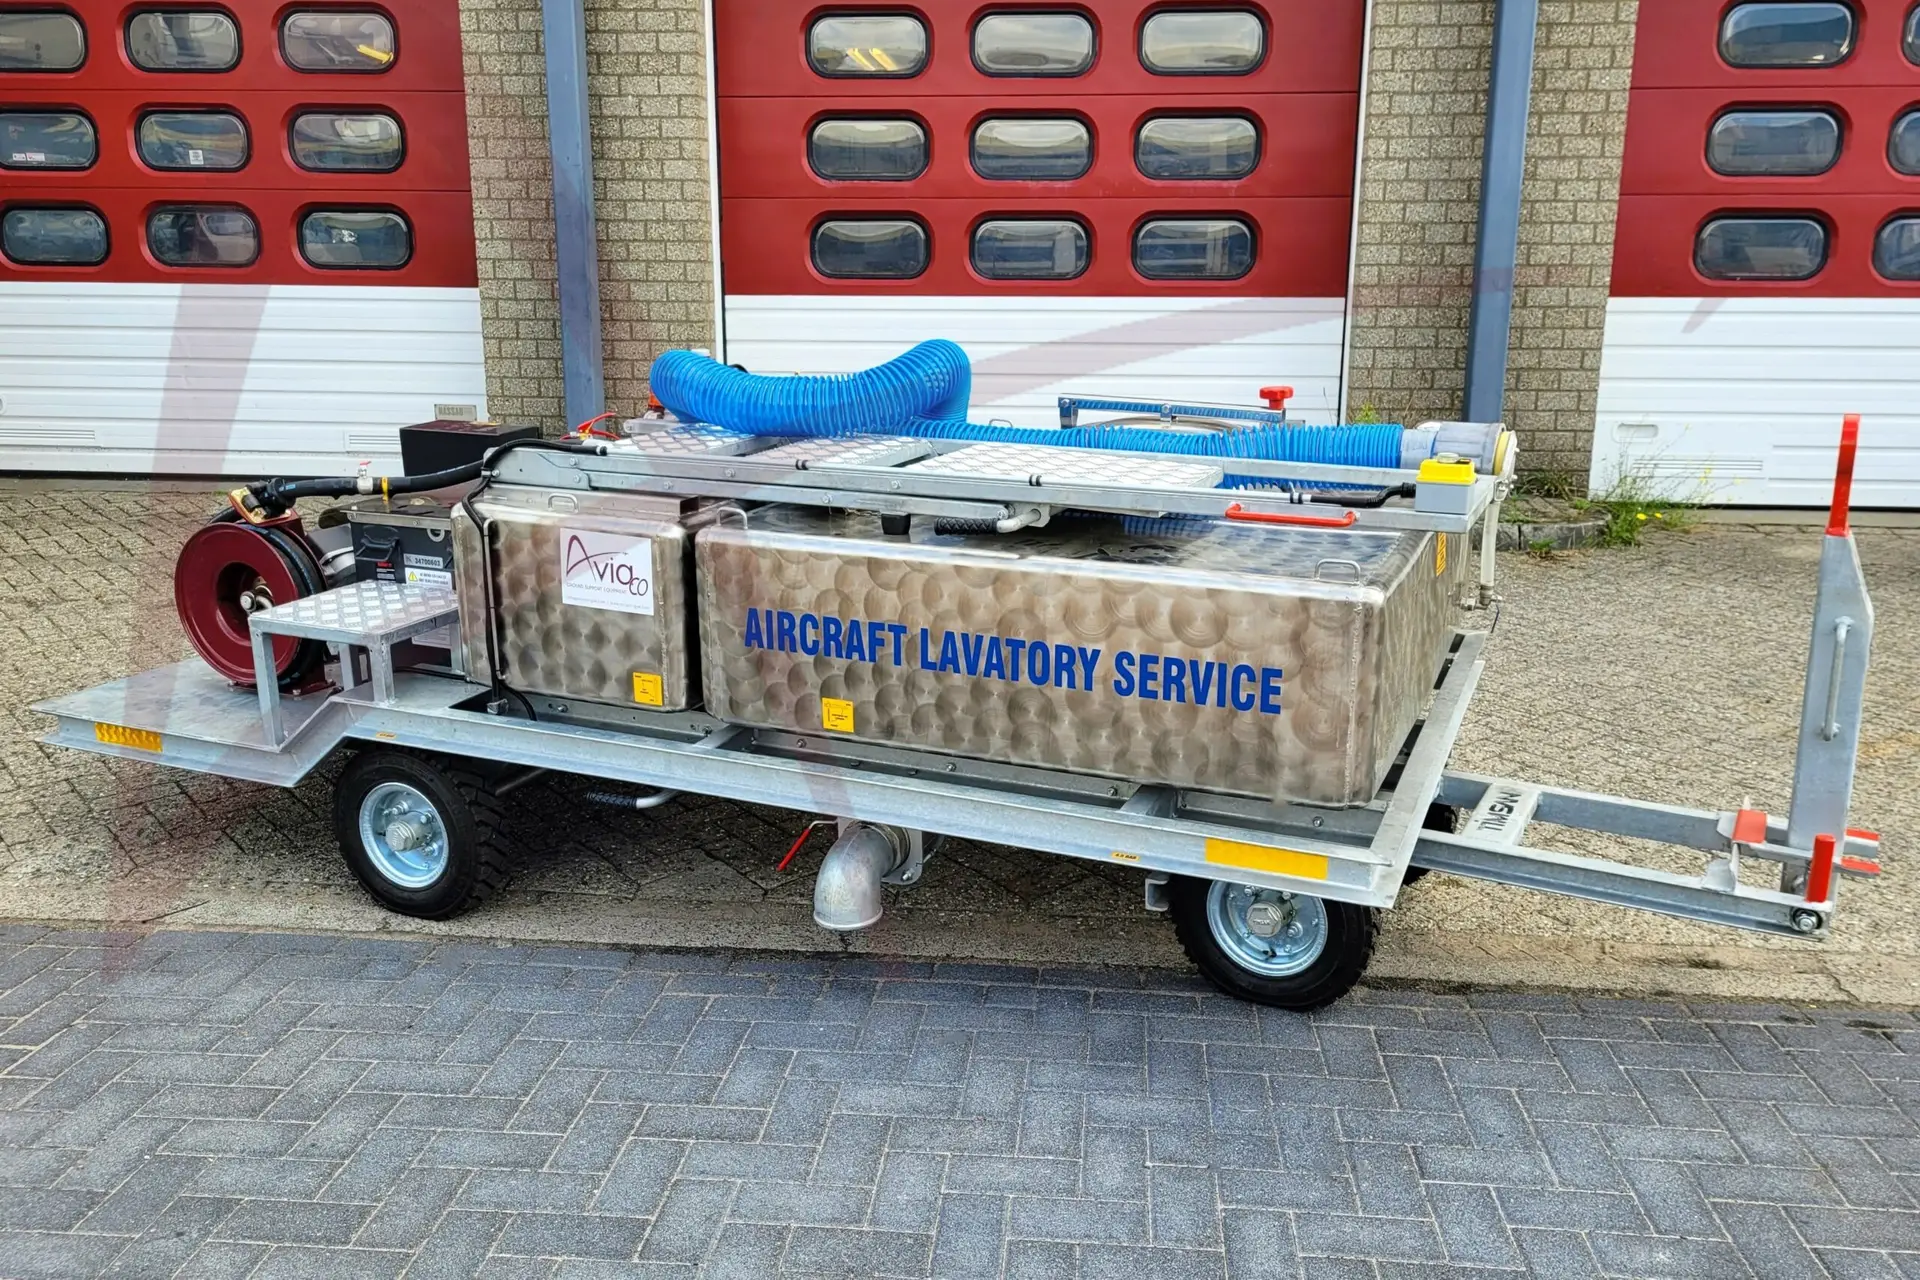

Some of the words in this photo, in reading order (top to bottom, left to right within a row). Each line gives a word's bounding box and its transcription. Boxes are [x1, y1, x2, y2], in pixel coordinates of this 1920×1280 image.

[744, 607, 908, 667] AIRCRAFT
[920, 627, 1102, 692] LAVATORY
[1113, 650, 1283, 715] SERVICE
